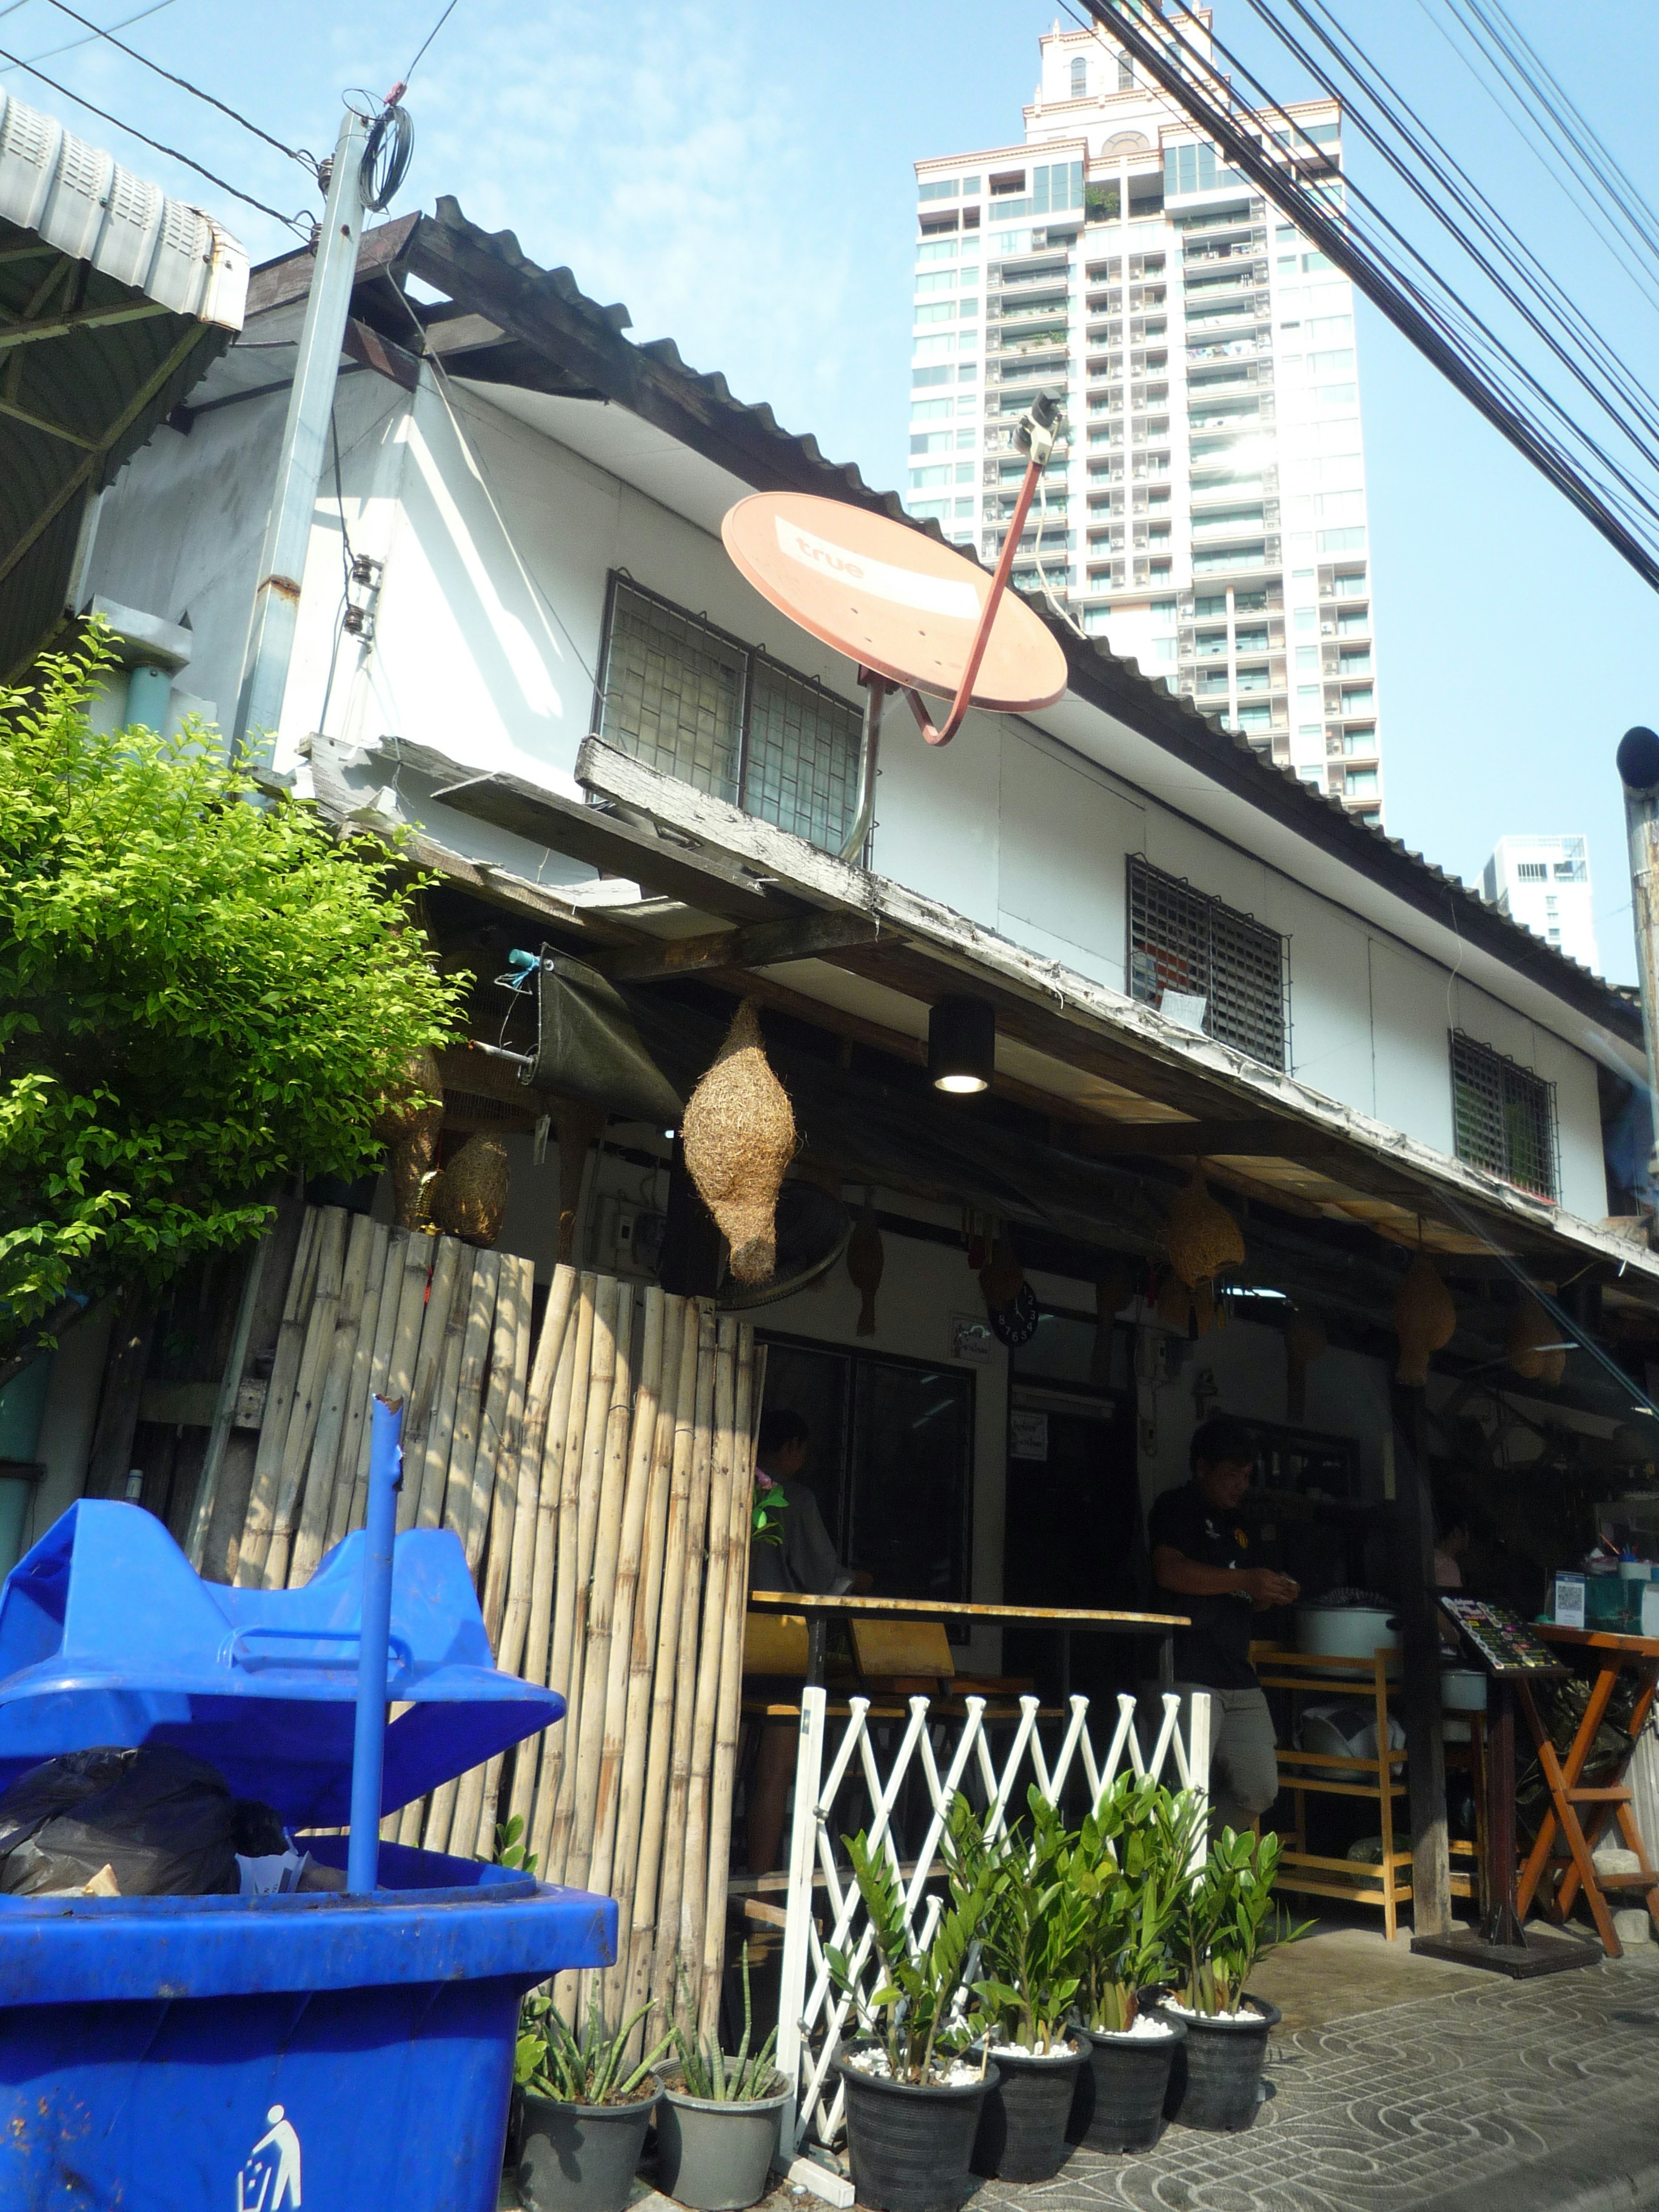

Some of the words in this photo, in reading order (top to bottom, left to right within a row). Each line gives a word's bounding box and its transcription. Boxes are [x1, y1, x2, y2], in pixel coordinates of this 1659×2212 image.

[796, 537, 864, 578] true
[1028, 1295, 1033, 1305] 2
[999, 1315, 1005, 1324] 8
[1030, 1310, 1036, 1320] 3
[1004, 1326, 1010, 1335] 7
[1027, 1321, 1032, 1332] 4
[1011, 1332, 1019, 1342] 6
[1021, 1330, 1027, 1340] 5
